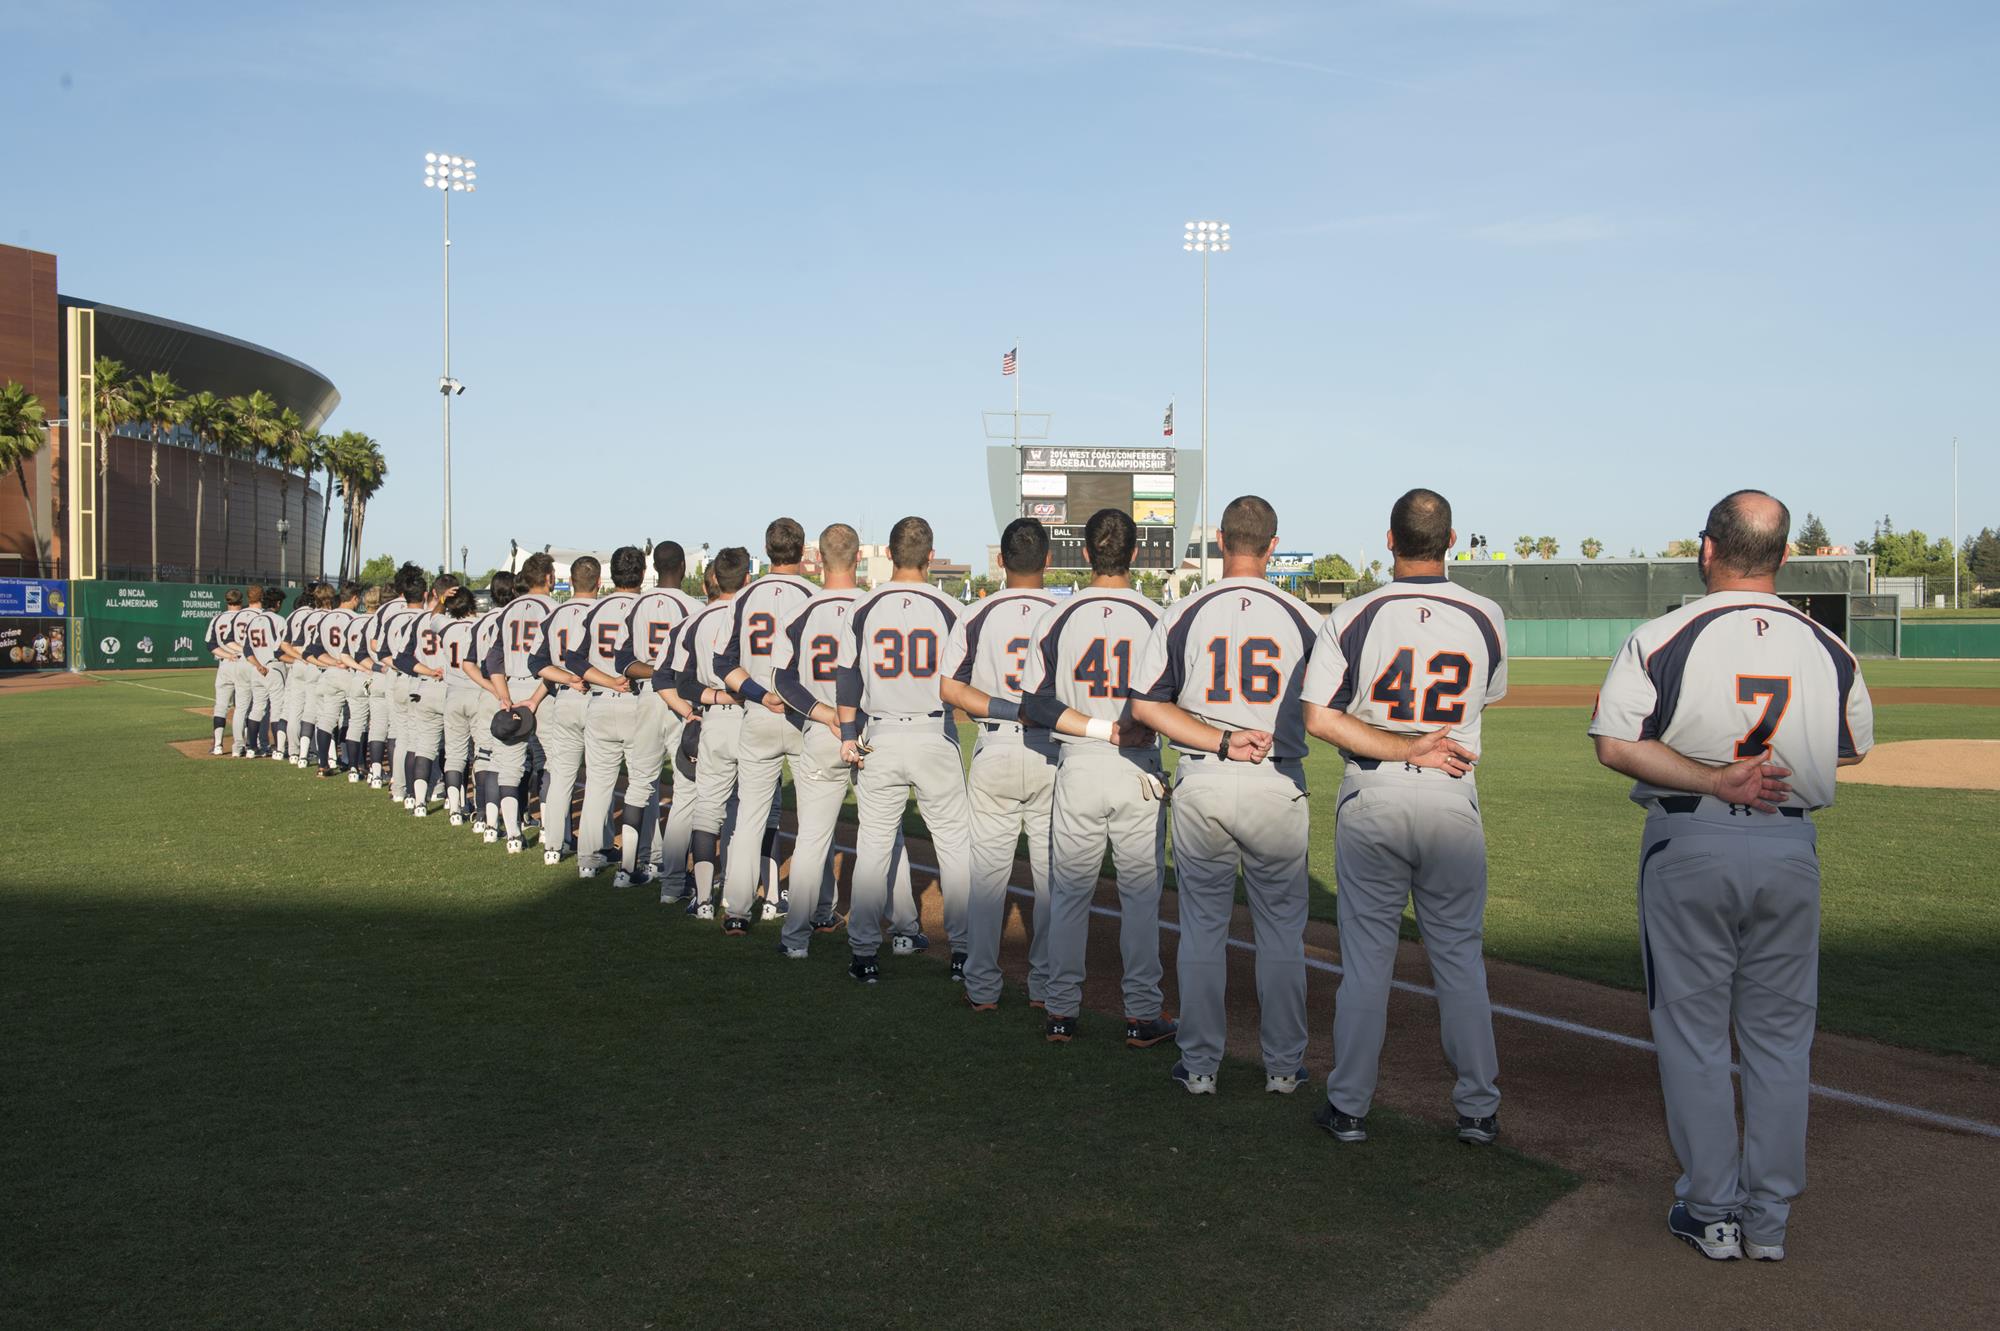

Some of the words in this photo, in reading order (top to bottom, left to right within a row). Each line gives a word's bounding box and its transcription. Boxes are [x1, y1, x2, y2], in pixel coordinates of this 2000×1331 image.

[1050, 459, 1096, 468] BASEBALL
[1098, 460, 1167, 469] CHAMPIONSHIP
[1069, 451, 1089, 459] WEST
[1091, 451, 1116, 459] COAST
[1117, 452, 1167, 460] CONFERENCE
[128, 589, 145, 597] NCAA
[198, 591, 213, 599] NCAA
[774, 587, 783, 597] P
[106, 599, 158, 608] ALL-AMERICANS
[836, 605, 845, 617] P
[902, 598, 911, 609] P
[1020, 604, 1031, 616] P
[1101, 606, 1113, 618] P
[1239, 597, 1251, 612] P
[1416, 607, 1431, 623] P
[329, 626, 341, 647] 6
[509, 620, 539, 653] 15
[749, 612, 776, 656] 2
[1750, 617, 1769, 637] P
[175, 637, 192, 652] LMU
[250, 628, 268, 648] 51
[421, 629, 438, 656] 3
[598, 623, 621, 659] 5
[648, 621, 670, 659] 5
[449, 641, 460, 668] 1
[811, 634, 840, 682] 2
[873, 628, 938, 680] 30
[1005, 637, 1032, 692] 3
[1074, 637, 1131, 700] 41
[1205, 636, 1281, 705] 16
[1370, 646, 1473, 725] 42
[1733, 673, 1792, 761] 7
